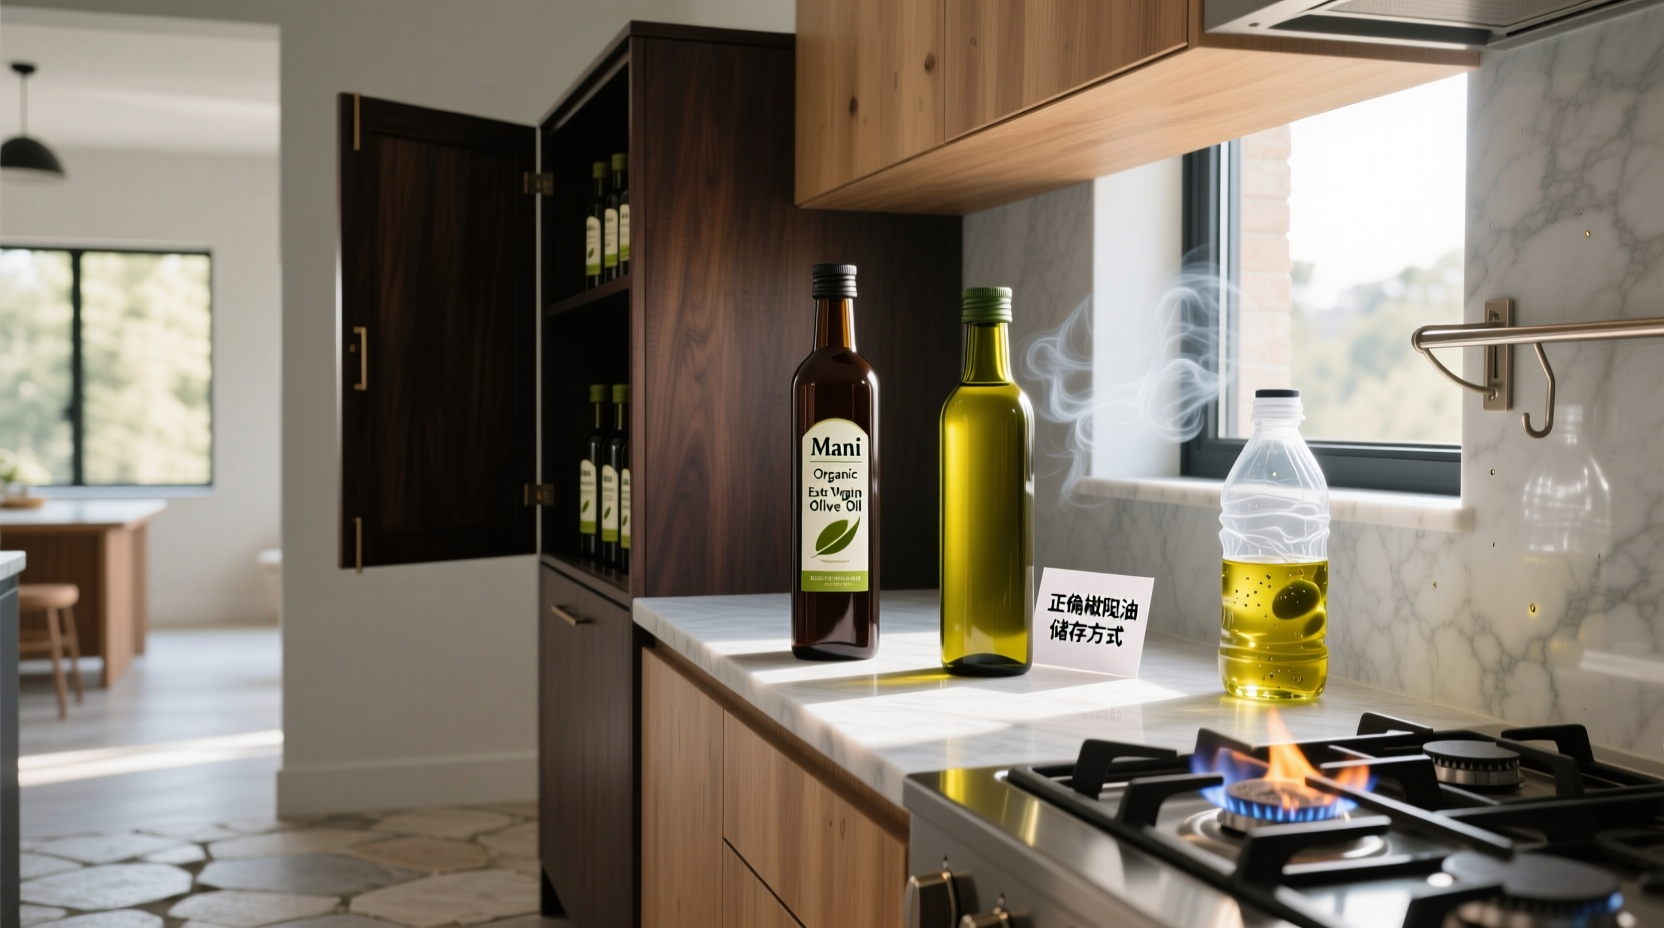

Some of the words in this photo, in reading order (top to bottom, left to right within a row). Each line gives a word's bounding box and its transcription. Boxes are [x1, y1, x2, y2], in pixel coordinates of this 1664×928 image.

[811, 436, 861, 457] Mani
[813, 468, 858, 483] Organic
[1049, 618, 1124, 647] 储存方式
